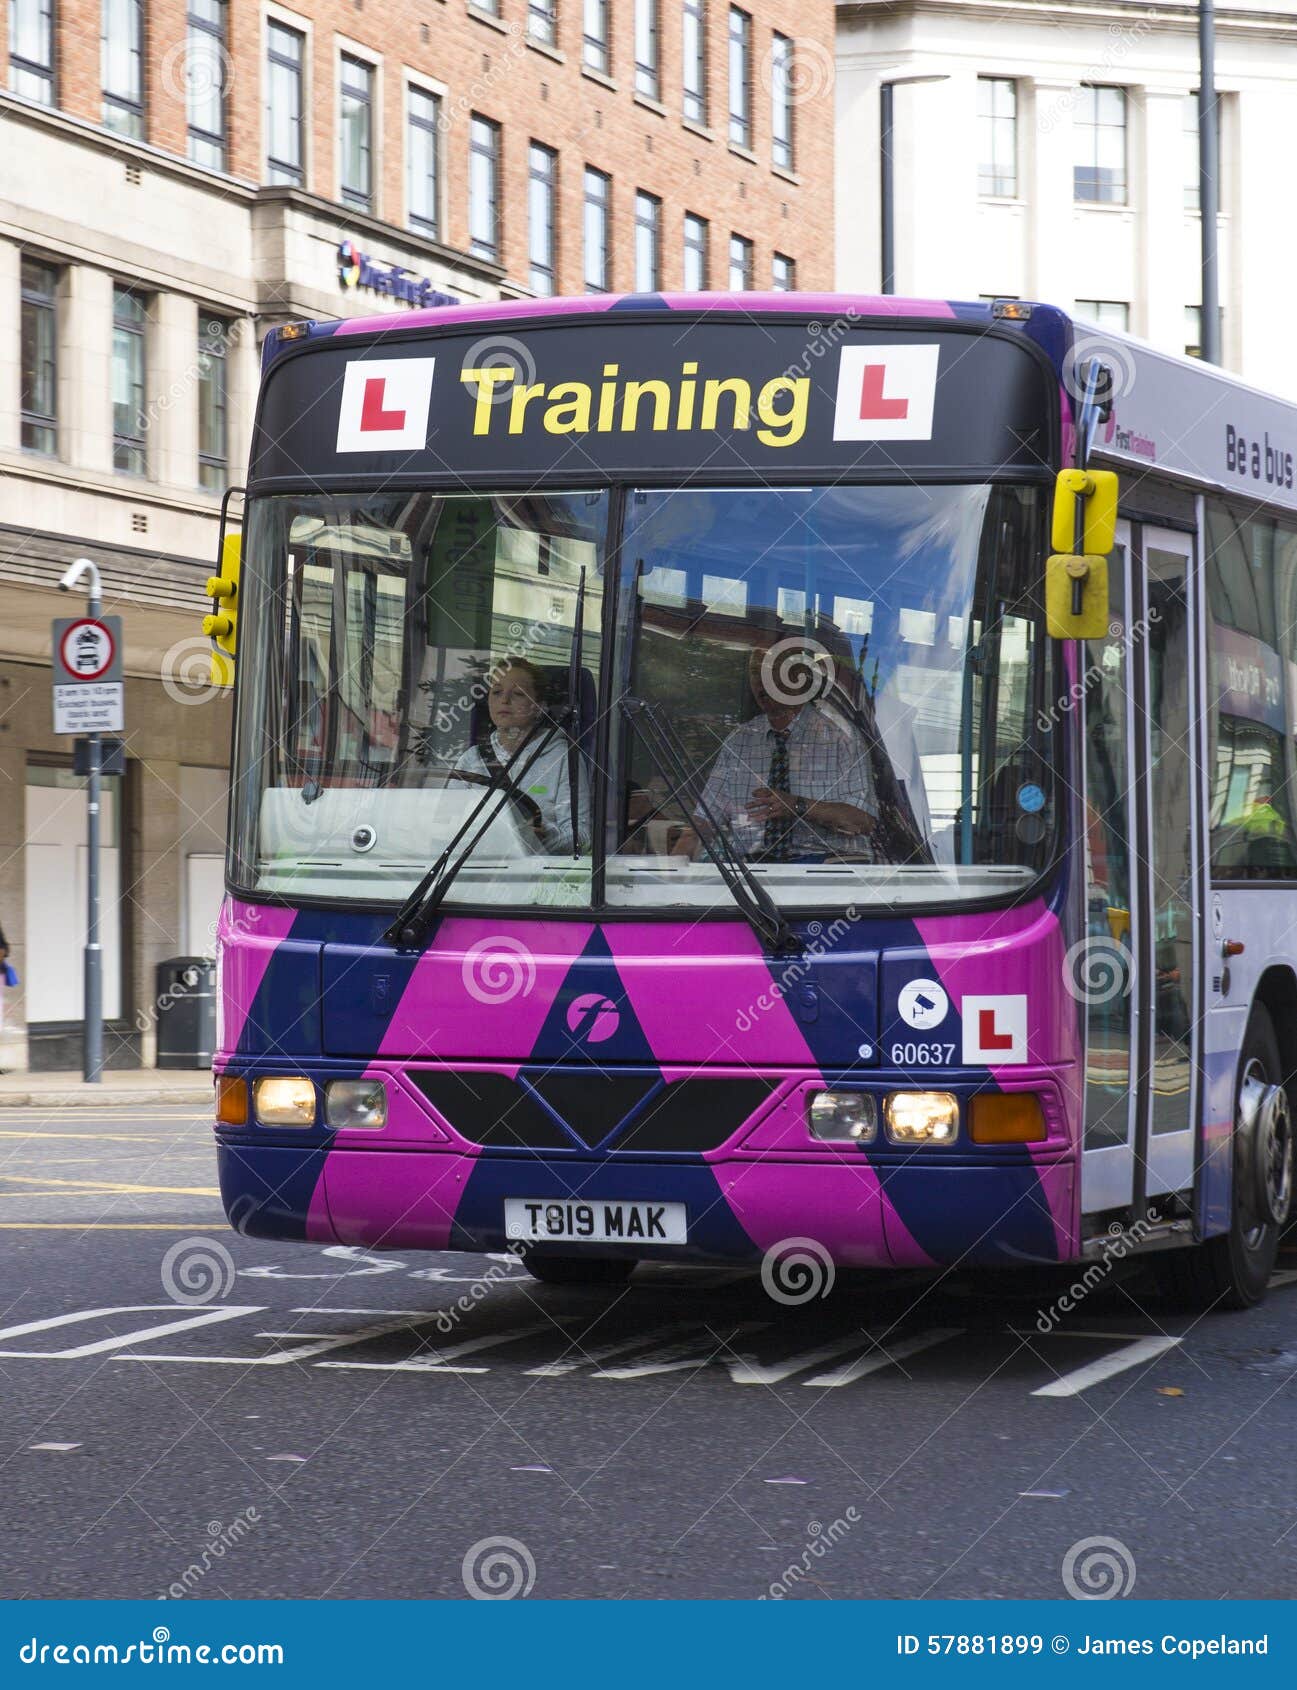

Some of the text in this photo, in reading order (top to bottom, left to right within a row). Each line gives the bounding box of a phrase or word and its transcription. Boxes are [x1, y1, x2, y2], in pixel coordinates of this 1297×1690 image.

[360, 378, 406, 432] L
[460, 362, 810, 447] Training
[859, 364, 909, 419] L
[1226, 424, 1293, 489] Be a bus
[891, 1043, 956, 1065] 60637
[979, 1009, 1012, 1050] L
[525, 1204, 667, 1238] T819 MAK
